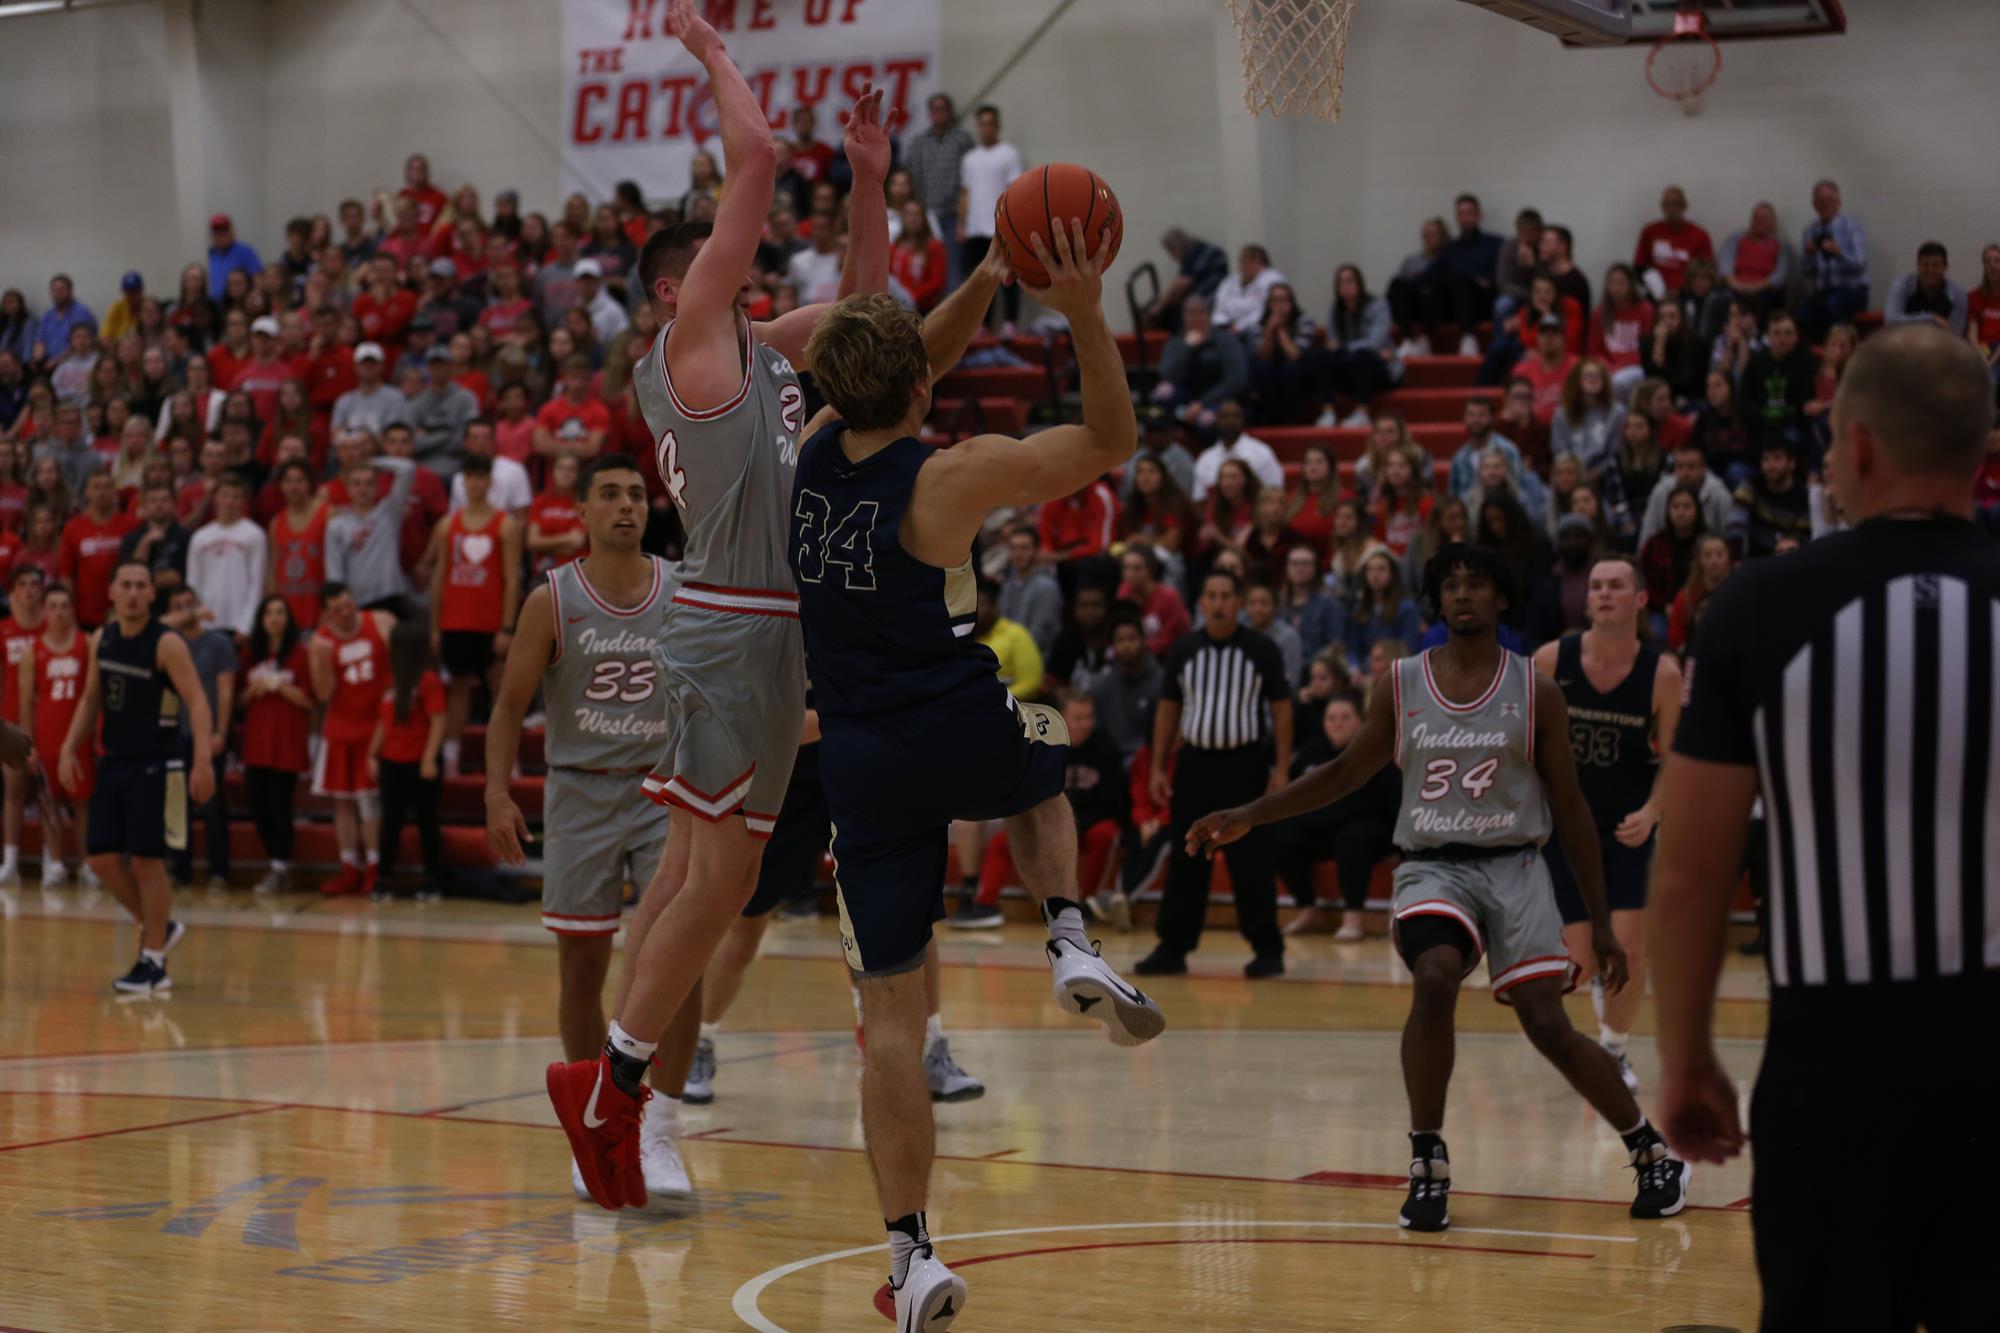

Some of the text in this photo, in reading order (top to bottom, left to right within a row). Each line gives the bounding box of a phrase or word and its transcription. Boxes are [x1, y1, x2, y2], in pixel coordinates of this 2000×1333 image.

[578, 47, 624, 75] THE
[573, 59, 928, 143] CATLYST
[795, 488, 879, 591] 34
[578, 627, 657, 655] Indian
[583, 659, 658, 704] 33
[574, 707, 667, 741] Wesleya
[1411, 722, 1508, 749] Indiana
[1419, 756, 1499, 802] 34
[1410, 807, 1518, 837] Wesleyan
